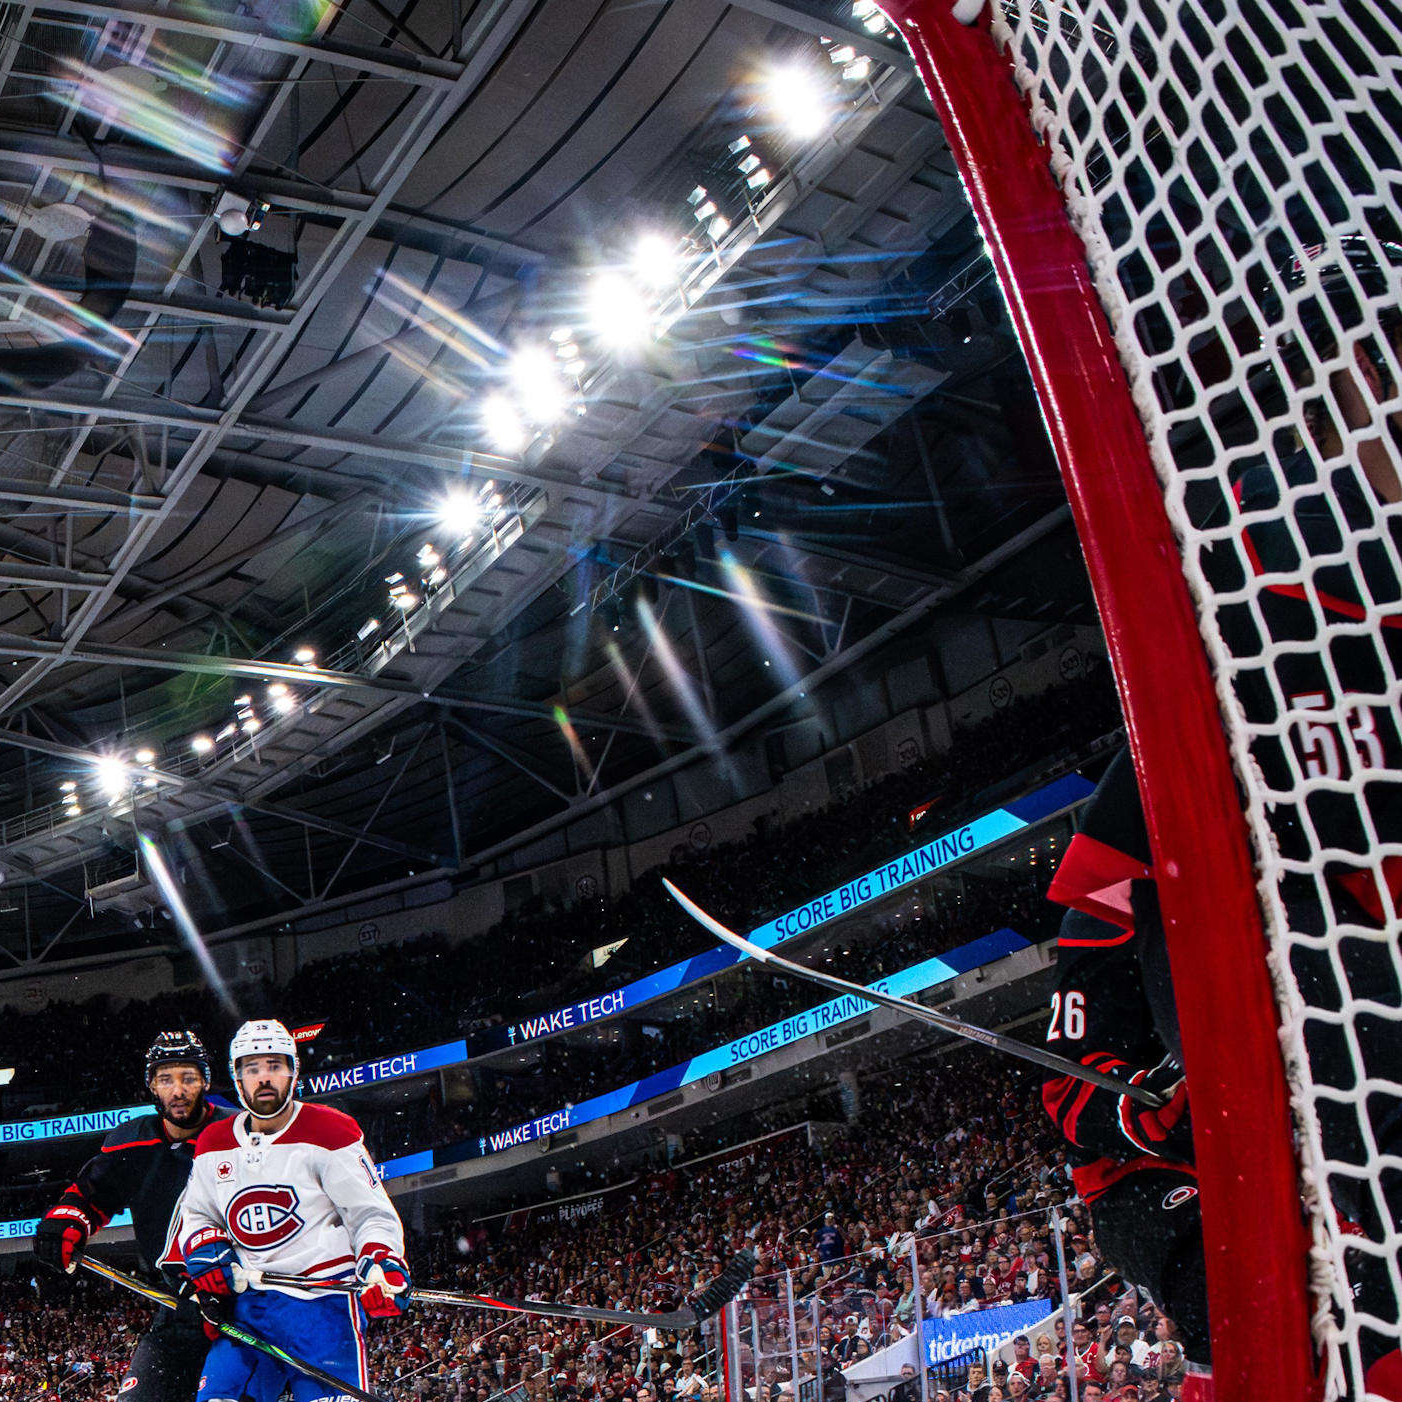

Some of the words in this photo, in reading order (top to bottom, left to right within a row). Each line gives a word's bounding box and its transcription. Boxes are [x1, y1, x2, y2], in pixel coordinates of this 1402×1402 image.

[1291, 691, 1385, 781] 53
[775, 894, 836, 942] SCORE
[840, 877, 871, 912] BIG
[875, 826, 975, 892] TRAINING
[520, 1008, 574, 1040] WAKE
[578, 990, 625, 1022] TECH
[1047, 991, 1086, 1042] 26
[730, 1026, 778, 1063] SCORE
[783, 1015, 808, 1042] BIG
[309, 1066, 364, 1094] WAKE
[368, 1054, 416, 1081] TECH
[3, 1124, 34, 1141] BIG
[40, 1110, 131, 1135] TRAINING
[490, 1124, 531, 1152] WAKE
[534, 1110, 570, 1137] TECH
[359, 1154, 379, 1189] 1
[9, 1221, 33, 1236] BIG
